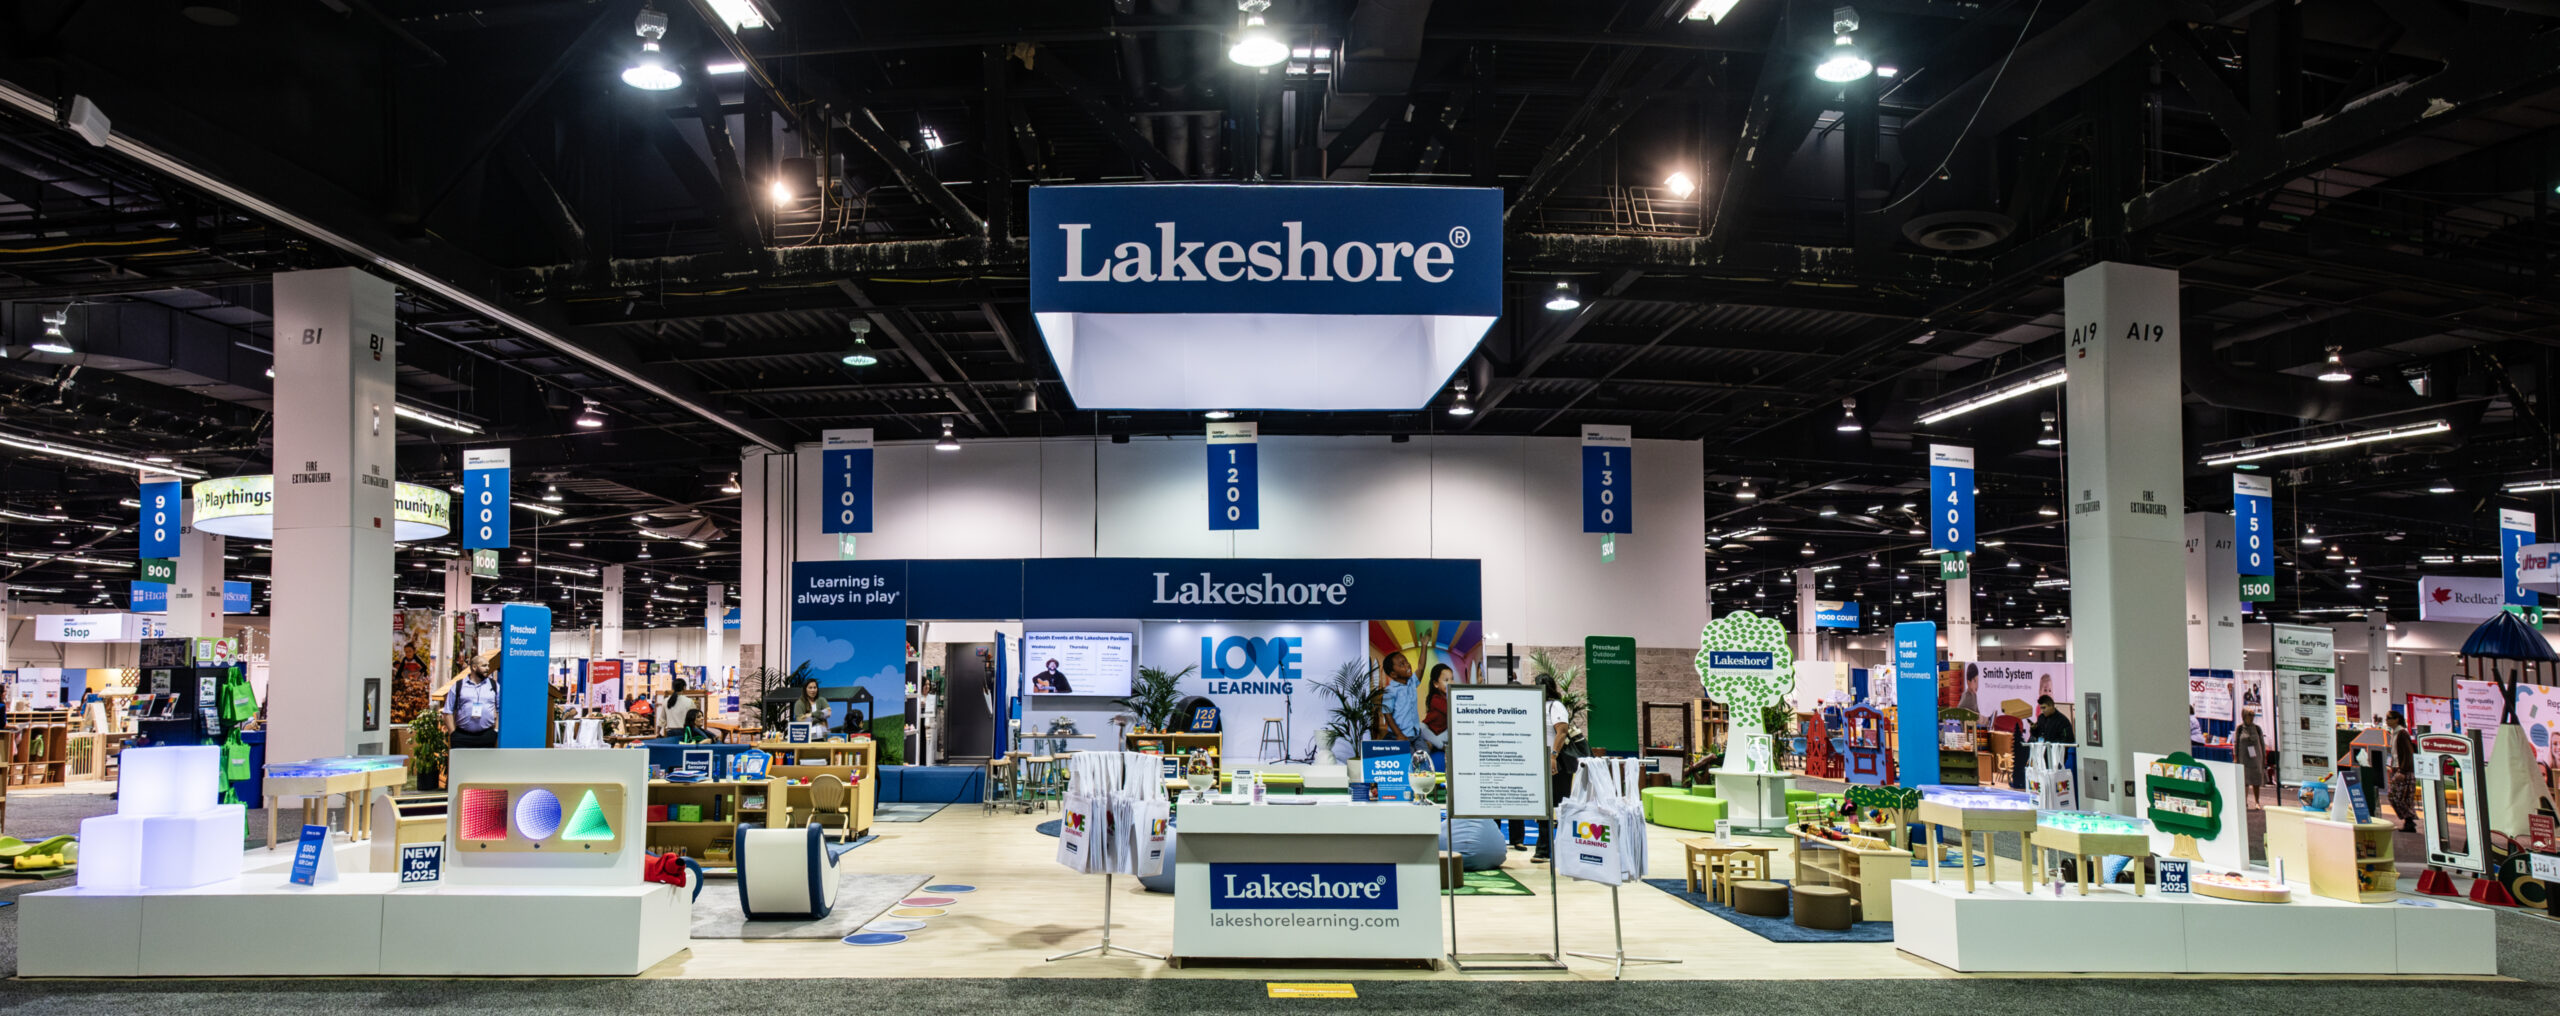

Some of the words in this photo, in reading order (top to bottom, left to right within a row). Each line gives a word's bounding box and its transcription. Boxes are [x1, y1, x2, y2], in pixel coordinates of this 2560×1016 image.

[841, 455, 854, 525] 1100
[1227, 449, 1240, 521] 1200
[1601, 451, 1614, 524] 1300
[205, 488, 272, 510] Playthings
[480, 474, 492, 540] 1000
[1947, 472, 1959, 542] 1400
[154, 495, 166, 542] 900
[2249, 500, 2260, 567] 1500
[475, 555, 496, 570] 1000
[1943, 559, 1965, 573] 1400
[147, 565, 171, 578] 900
[810, 576, 869, 589] Learning
[873, 575, 885, 587] is
[2242, 583, 2270, 596] 1500
[797, 592, 844, 606] always
[849, 591, 861, 603] in
[1836, 614, 1858, 622] COURT
[63, 627, 90, 639] Shop
[1983, 665, 2004, 679] Smith
[1208, 681, 1293, 695] LEARNING
[1456, 707, 1496, 715] Lakeshore
[1374, 760, 1400, 769] $500
[1575, 838, 1608, 848] LEARNING
[404, 847, 438, 859] NEW
[411, 859, 431, 870] for
[2160, 862, 2186, 872] NEW
[403, 870, 437, 882] 2025
[2166, 872, 2182, 882] for
[2161, 882, 2187, 892] 2025
[1210, 913, 1400, 931] lakeshorelearning.com
